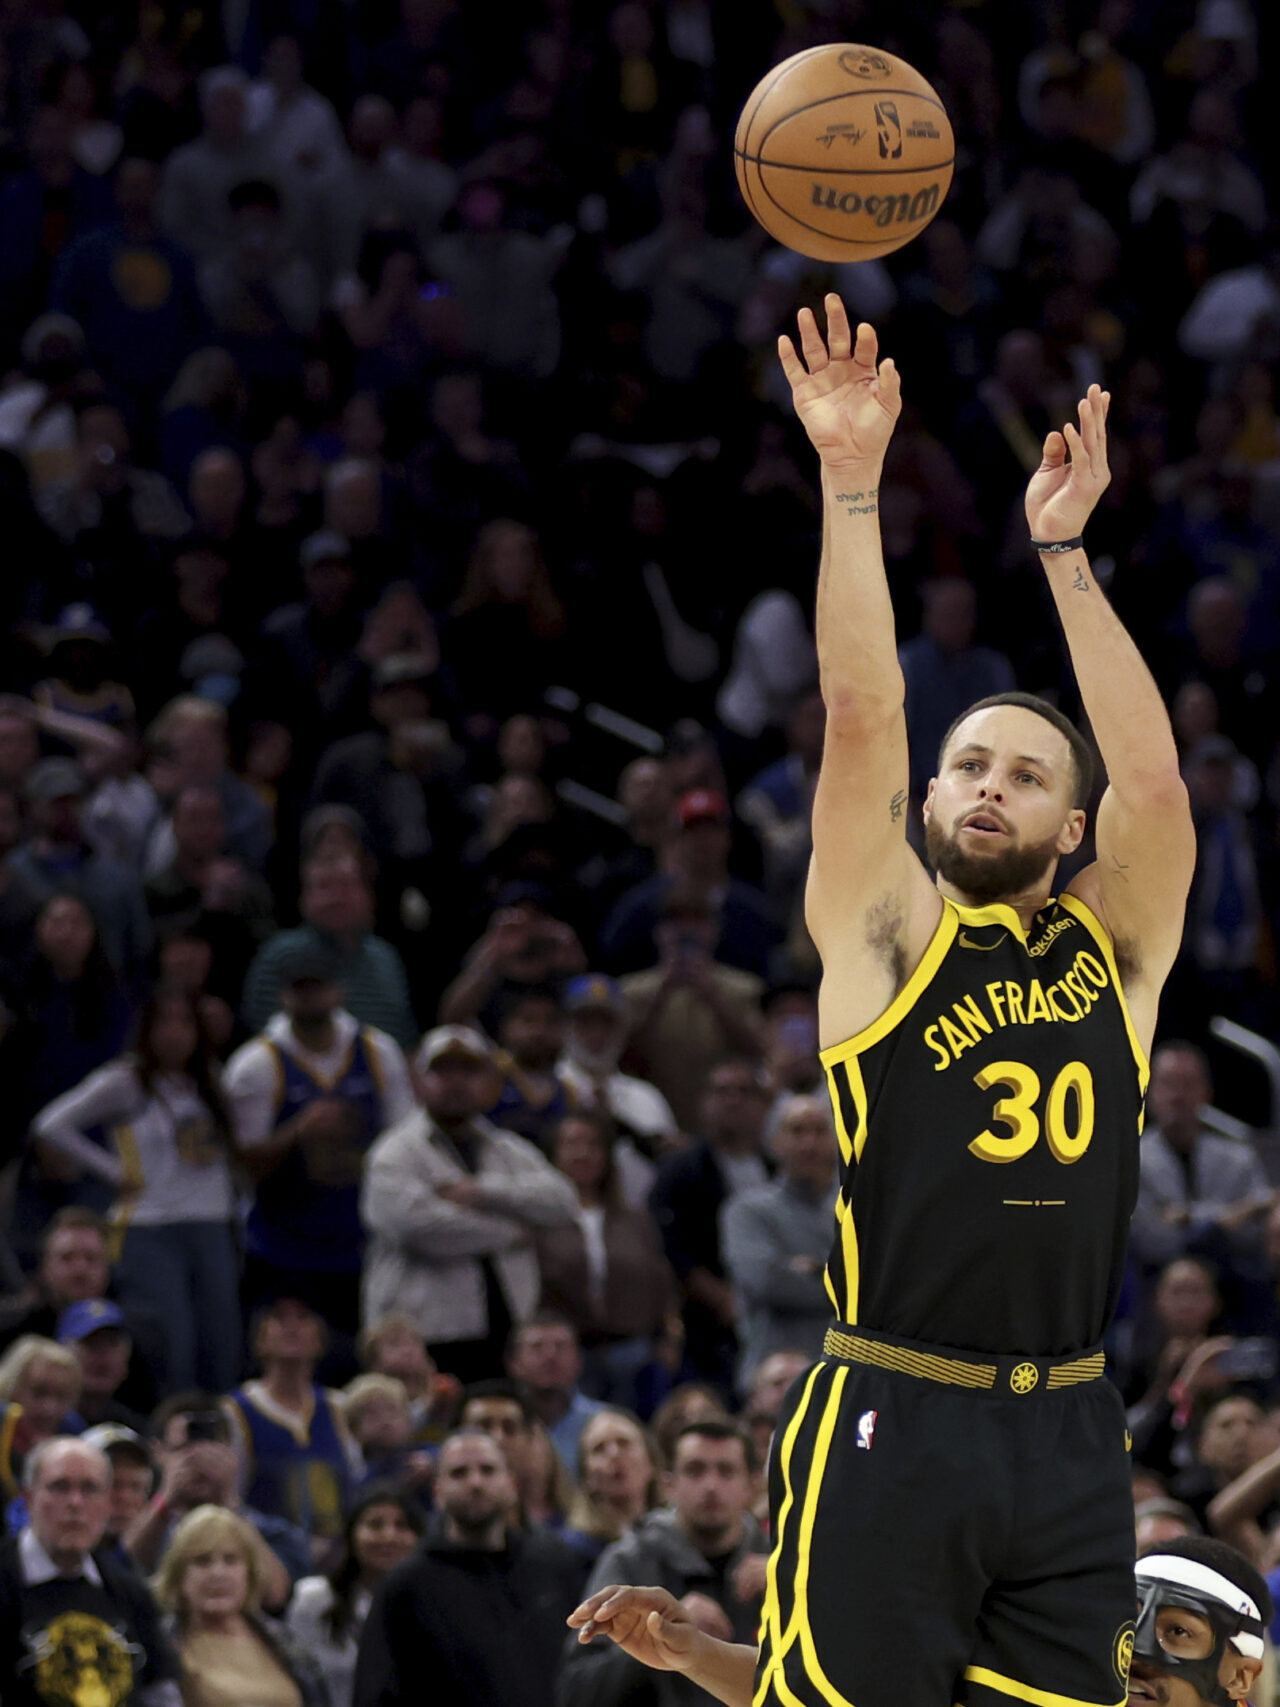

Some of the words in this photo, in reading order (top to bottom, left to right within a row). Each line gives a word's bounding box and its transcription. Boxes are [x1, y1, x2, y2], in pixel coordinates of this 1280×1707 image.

[811, 182, 940, 228] Wilson
[1029, 918, 1077, 957] akuten
[923, 993, 994, 1071] SAN
[985, 948, 1109, 1027] FRACISCO
[967, 1060, 1095, 1165] 30
